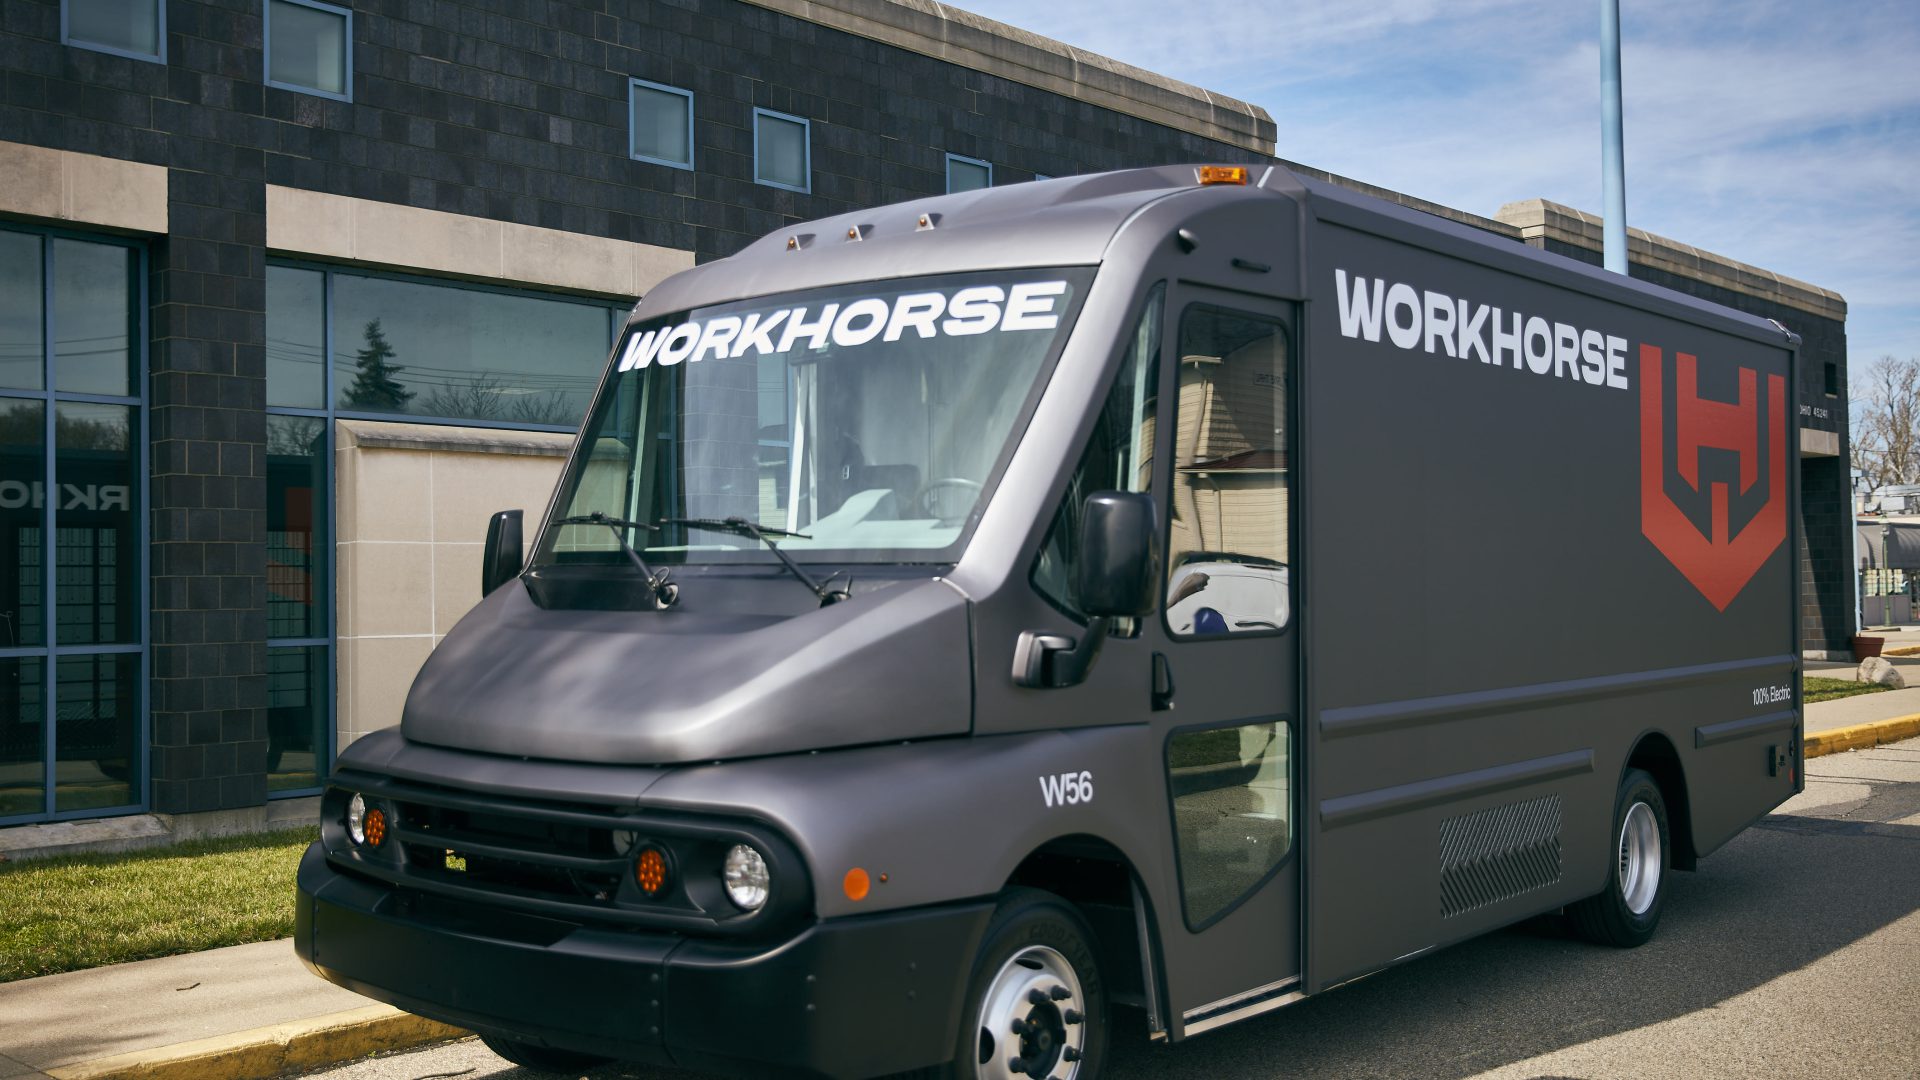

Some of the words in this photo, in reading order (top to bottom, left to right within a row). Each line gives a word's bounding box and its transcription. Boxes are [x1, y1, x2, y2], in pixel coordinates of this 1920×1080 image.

[618, 280, 1067, 373] WORKHORSE
[1334, 268, 1629, 391] WORKHORSE
[1752, 687, 1769, 706] 100%
[1770, 684, 1791, 703] Electric
[1039, 771, 1093, 808] W56
